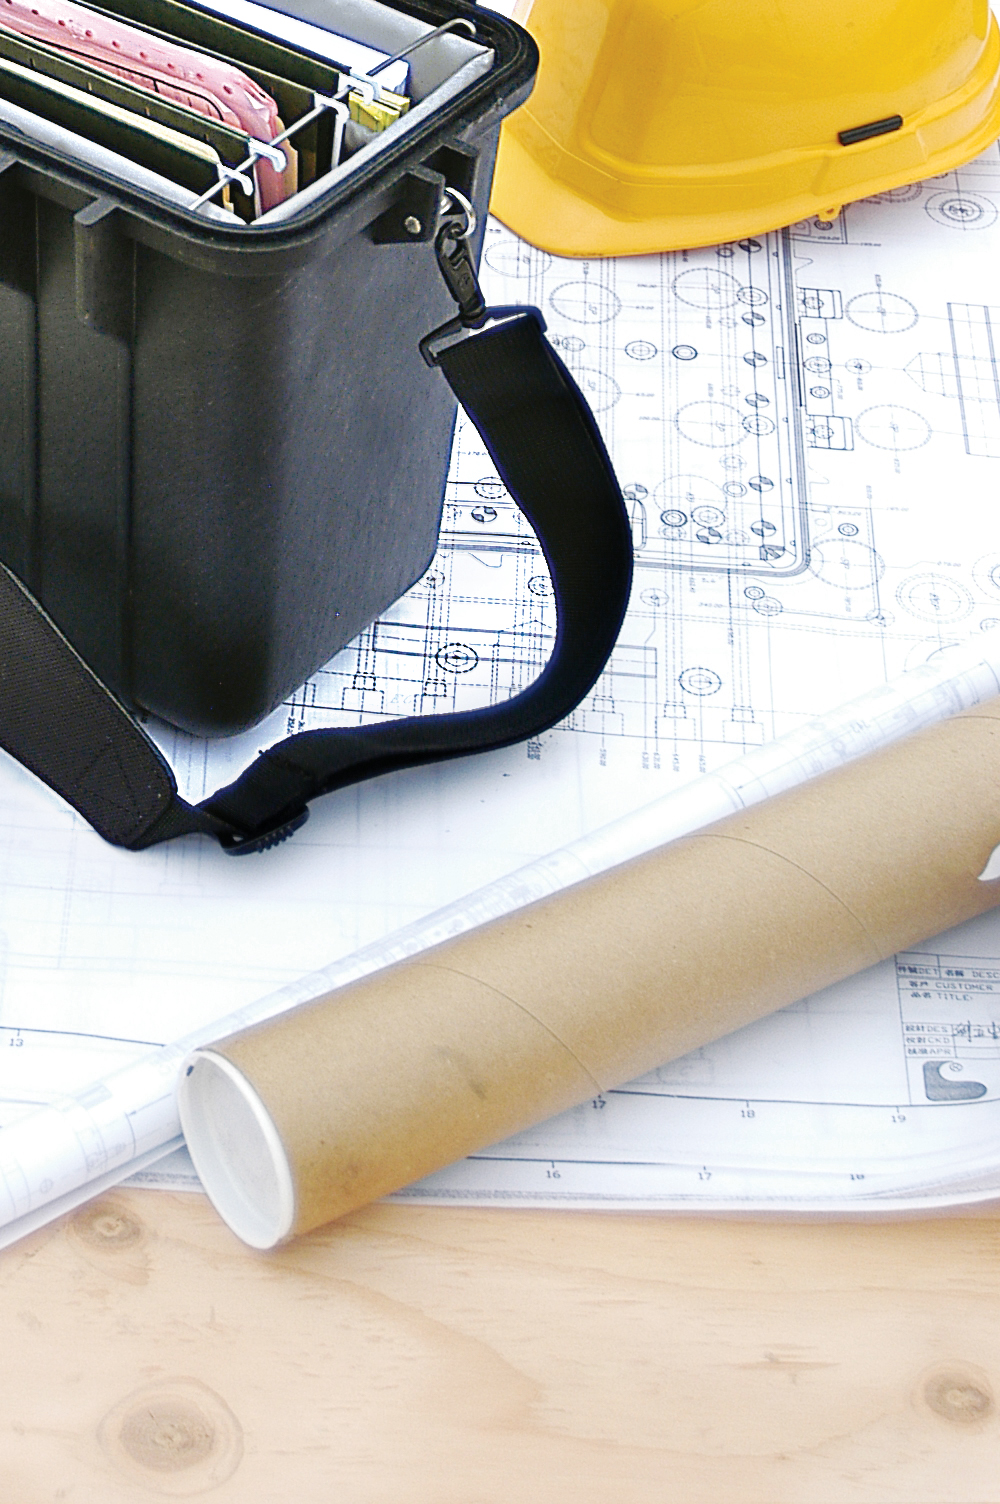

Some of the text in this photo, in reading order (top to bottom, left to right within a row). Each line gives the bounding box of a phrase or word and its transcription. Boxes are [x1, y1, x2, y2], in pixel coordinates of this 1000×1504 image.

[935, 982, 994, 991] CUSTOMER
[8, 1038, 24, 1047] 13
[592, 1098, 607, 1110] 17
[740, 1109, 756, 1119] 18
[890, 1114, 907, 1124] 19
[546, 1169, 561, 1179] 16
[697, 1170, 712, 1180] 17
